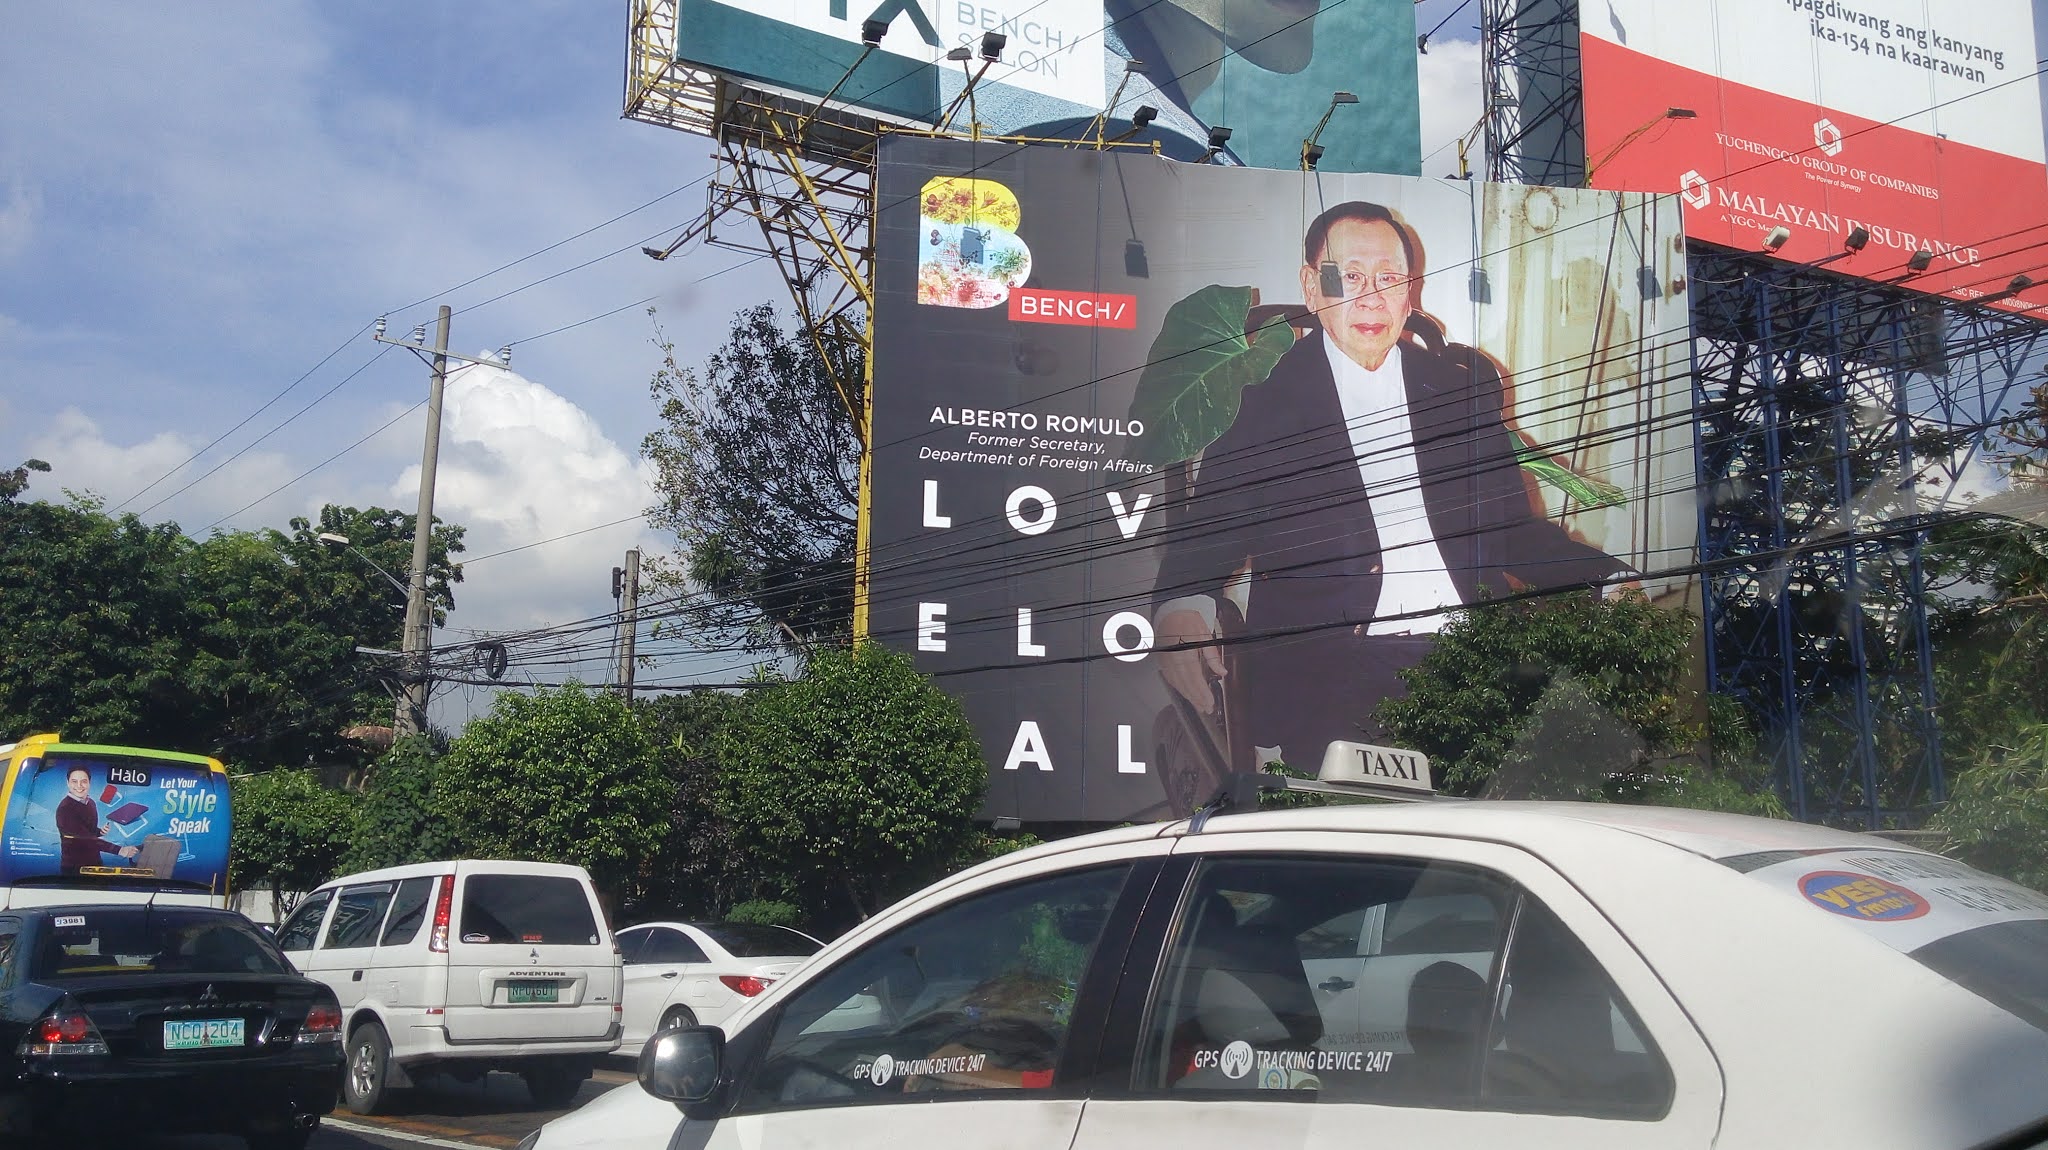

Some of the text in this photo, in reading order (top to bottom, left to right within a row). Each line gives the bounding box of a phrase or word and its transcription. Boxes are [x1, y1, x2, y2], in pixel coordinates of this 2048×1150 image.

[958, 0, 1080, 55] BENCH/
[1786, 0, 2005, 70] pagdiwang ang kanyang
[957, 32, 1058, 80] SLON
[1810, 19, 1986, 84] ika-154 na kaarawan
[1715, 132, 1939, 200] YUCHENGCO GROUP OF COMPANIES
[1804, 172, 1861, 193] The Power of Synergy
[1716, 187, 1840, 233] MALAYAN
[1720, 214, 1728, 222] A
[1728, 214, 1756, 229] YGC
[1021, 296, 1126, 321] BENCH/
[929, 406, 1144, 437] ALBERTO ROMULO
[967, 432, 1106, 455] Former Secretary,
[919, 446, 1153, 474] Department of Foreign Affairs
[923, 479, 1153, 539] L O V
[918, 602, 1155, 662] E L O
[1003, 721, 1146, 774] A L
[1356, 749, 1420, 781] TAXI
[160, 778, 197, 789] Let Your
[163, 789, 217, 819] Style
[168, 817, 211, 837] Speak
[210, 1021, 239, 1039] 204
[854, 1054, 986, 1079] GPS TRACKING DEVICE 24/7
[1194, 1050, 1393, 1072] GPS TRACKING DEVICE 24/7
